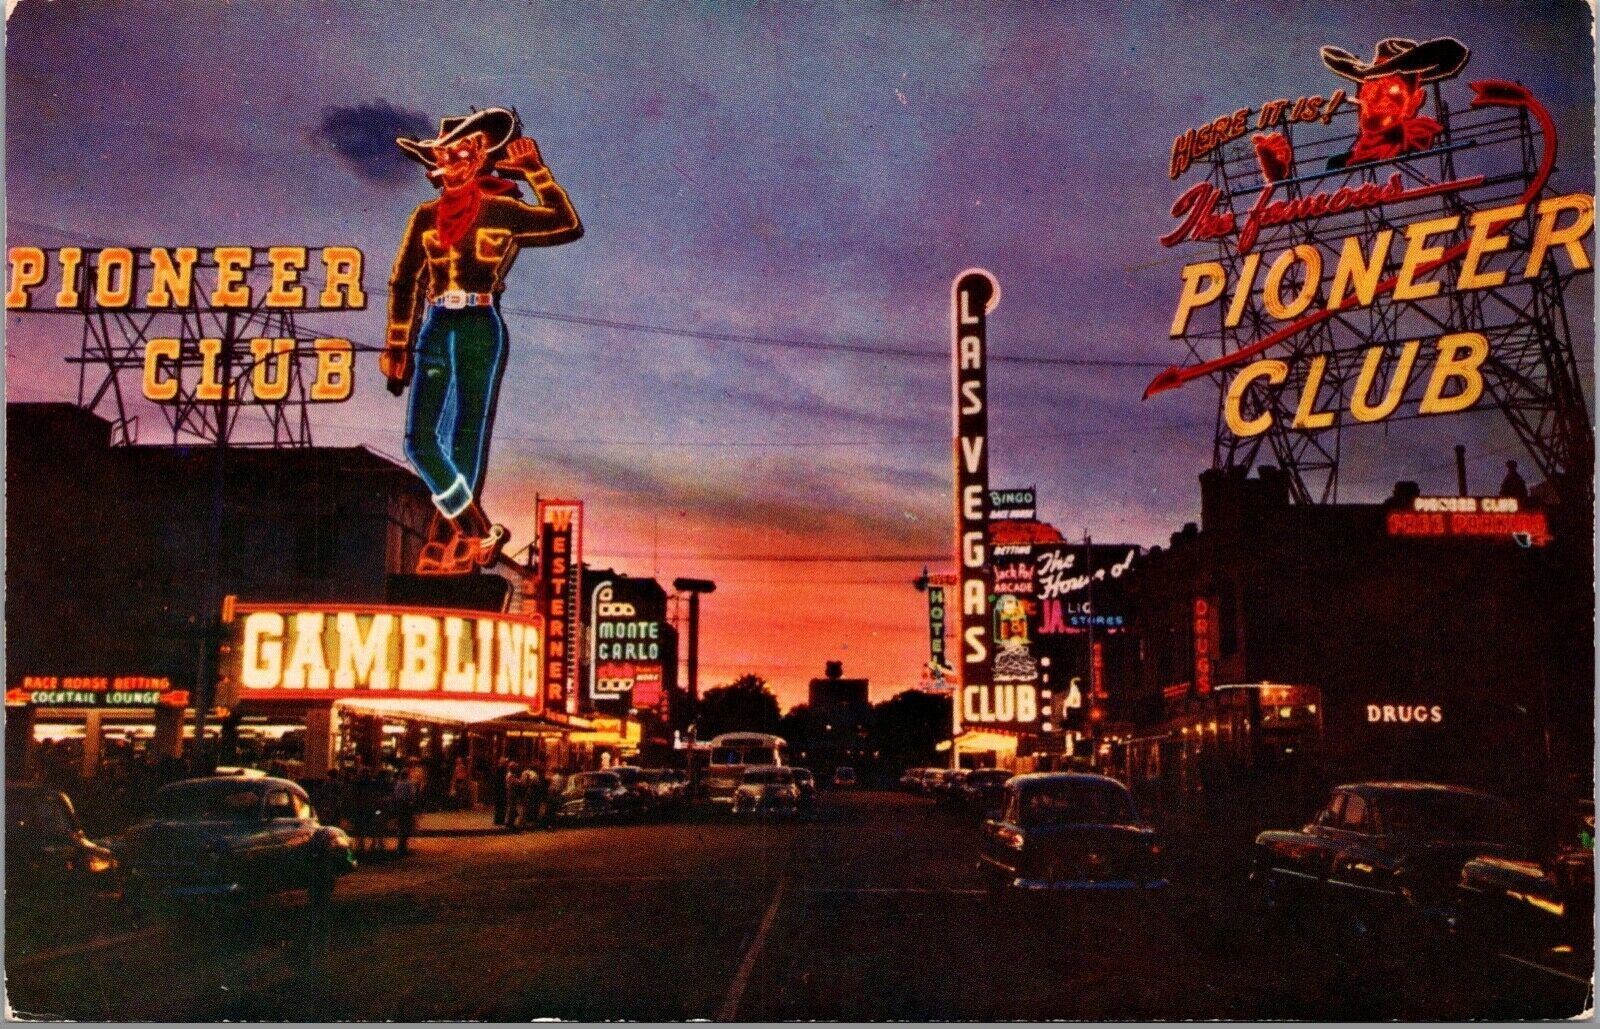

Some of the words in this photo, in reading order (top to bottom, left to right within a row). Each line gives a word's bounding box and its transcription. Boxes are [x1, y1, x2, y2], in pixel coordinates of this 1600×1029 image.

[1168, 108, 1250, 180] HERE
[1256, 99, 1289, 129] IT
[1290, 89, 1346, 125] IS!
[1159, 181, 1235, 248] The
[1236, 173, 1405, 254] famous
[7, 246, 365, 309] PIONEER
[1169, 193, 1595, 337] PIONEER
[142, 337, 355, 400] CLUB
[960, 289, 984, 416] LAS
[1224, 331, 1490, 438] CLUB
[989, 491, 1033, 506] BINGO
[961, 436, 987, 664] VEGAS
[1037, 550, 1075, 576] The
[548, 511, 572, 700] WESTERNER
[993, 582, 1033, 593] ARCADE
[241, 611, 539, 698] GAMBLING
[599, 622, 658, 639] MONTE
[599, 643, 658, 660] CARLO
[930, 590, 944, 669] HOTEL
[31, 691, 96, 704] COCKTAIL
[105, 691, 160, 704] LOUNGE
[63, 677, 108, 690] HORSE
[113, 677, 170, 690] BETTING
[963, 684, 1037, 722] CLUB
[1366, 704, 1443, 723] DRUGS
